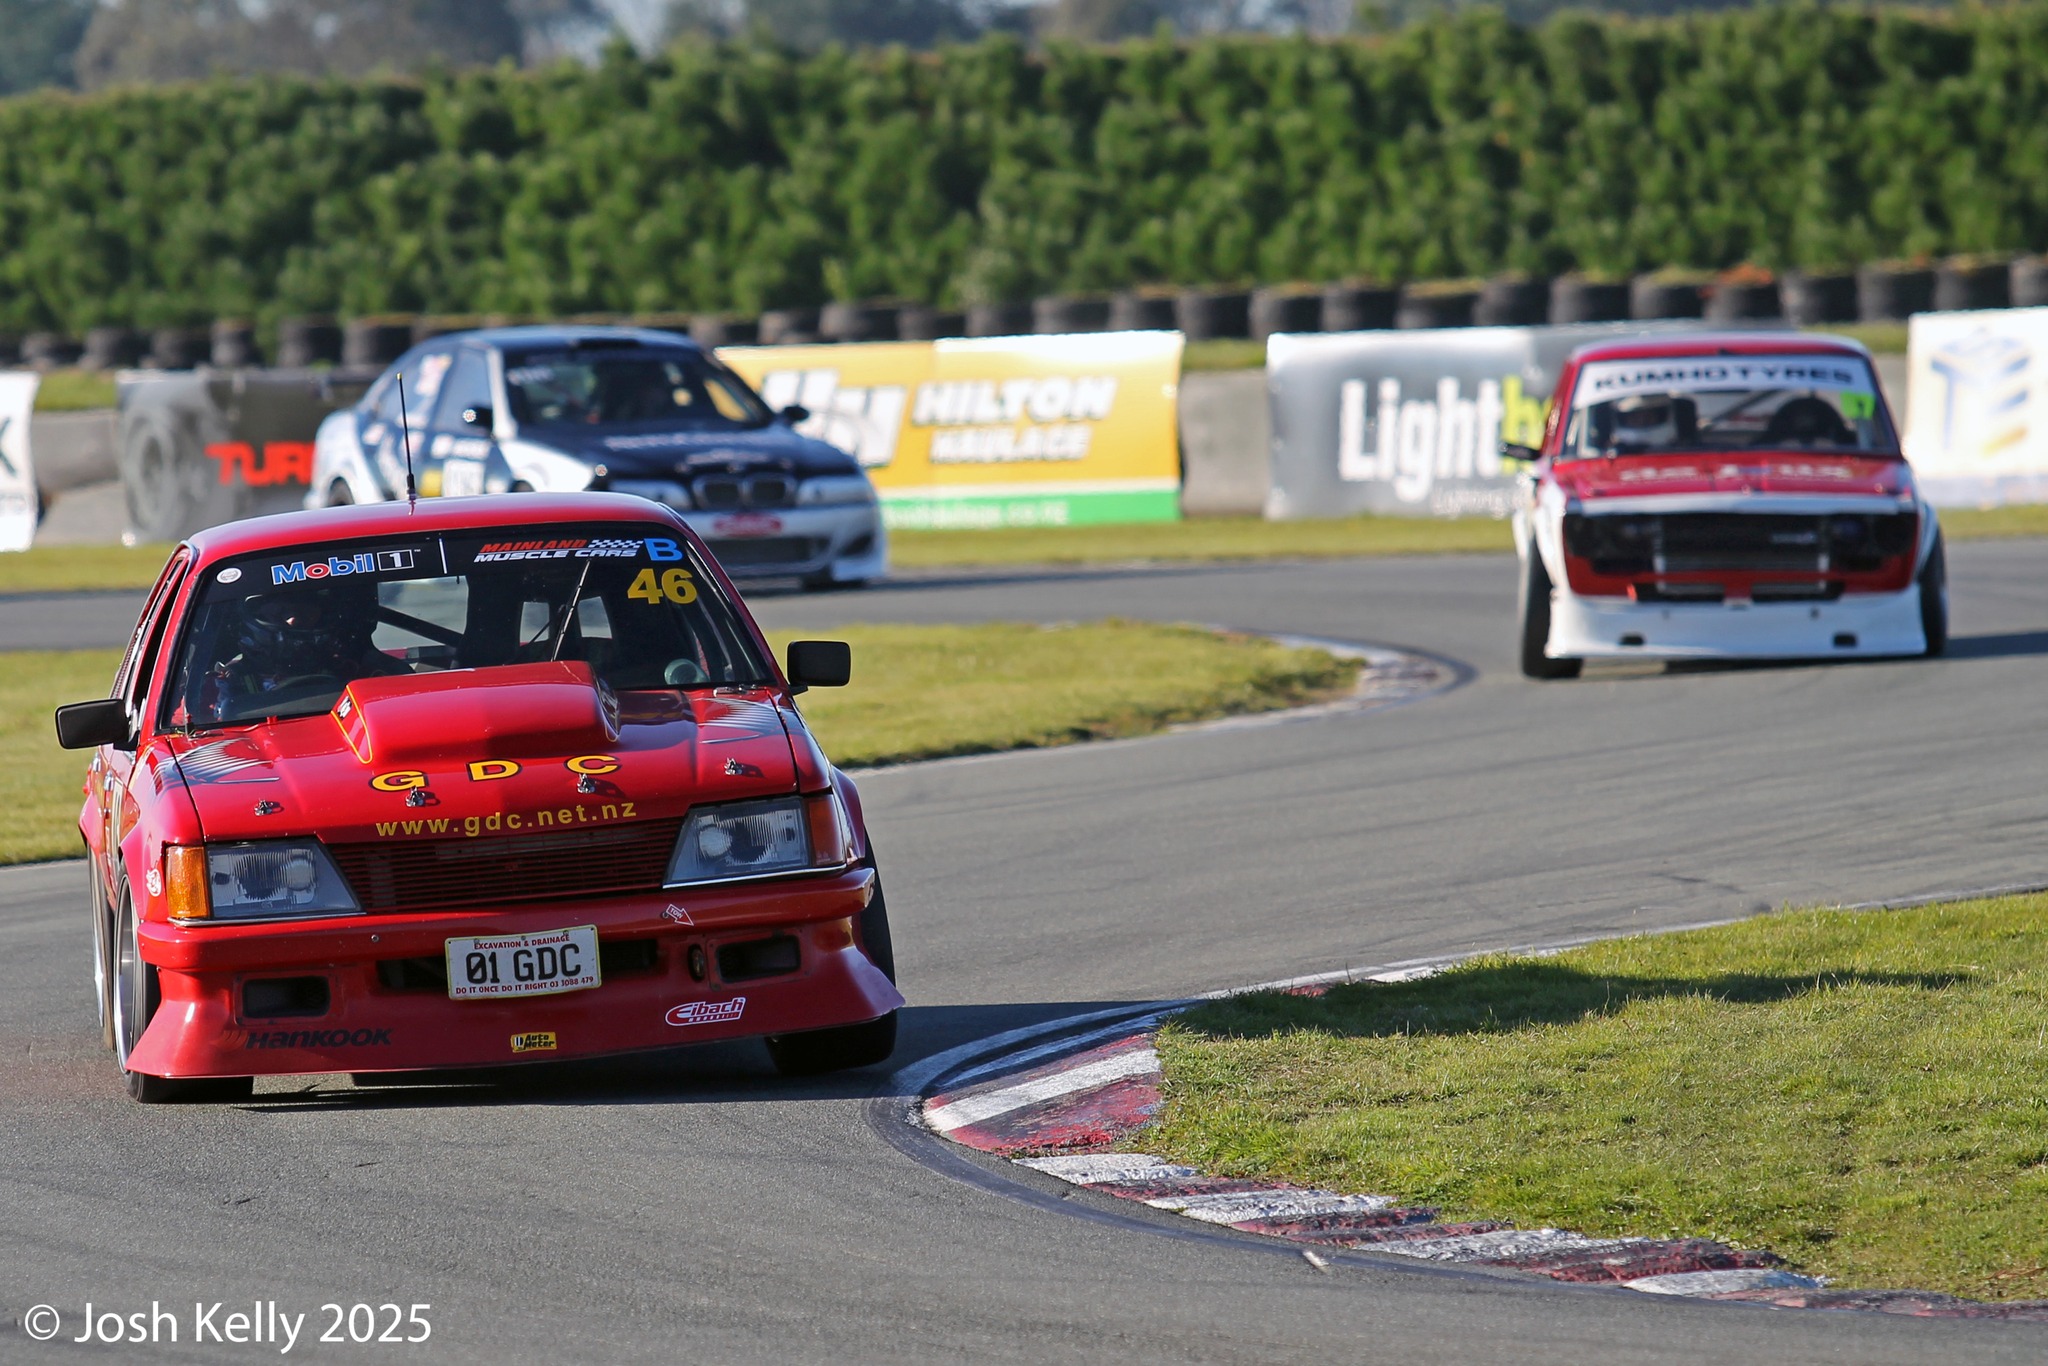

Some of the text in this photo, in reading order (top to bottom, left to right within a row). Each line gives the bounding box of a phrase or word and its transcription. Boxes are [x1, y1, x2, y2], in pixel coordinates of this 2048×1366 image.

[1595, 365, 1854, 389] KUMHO TYRES
[912, 376, 1118, 426] HILTON
[930, 425, 1093, 464] HAULAGE
[474, 549, 639, 563] MUSCLE CARS
[480, 539, 588, 553] MAINLAND
[643, 538, 683, 561] B
[271, 553, 375, 585] Mobil
[627, 568, 698, 605] 46
[376, 801, 637, 837] www.gdc.net.nz
[670, 907, 683, 919] TOW
[474, 933, 570, 950] EXCAVATION & DRAINAGE
[513, 943, 581, 982] GDC
[456, 987, 467, 995] DO
[469, 986, 476, 994] IT
[479, 985, 499, 993] ONCE
[502, 984, 513, 992] DO
[525, 981, 547, 990] RIGHT
[667, 998, 746, 1022] Eibach
